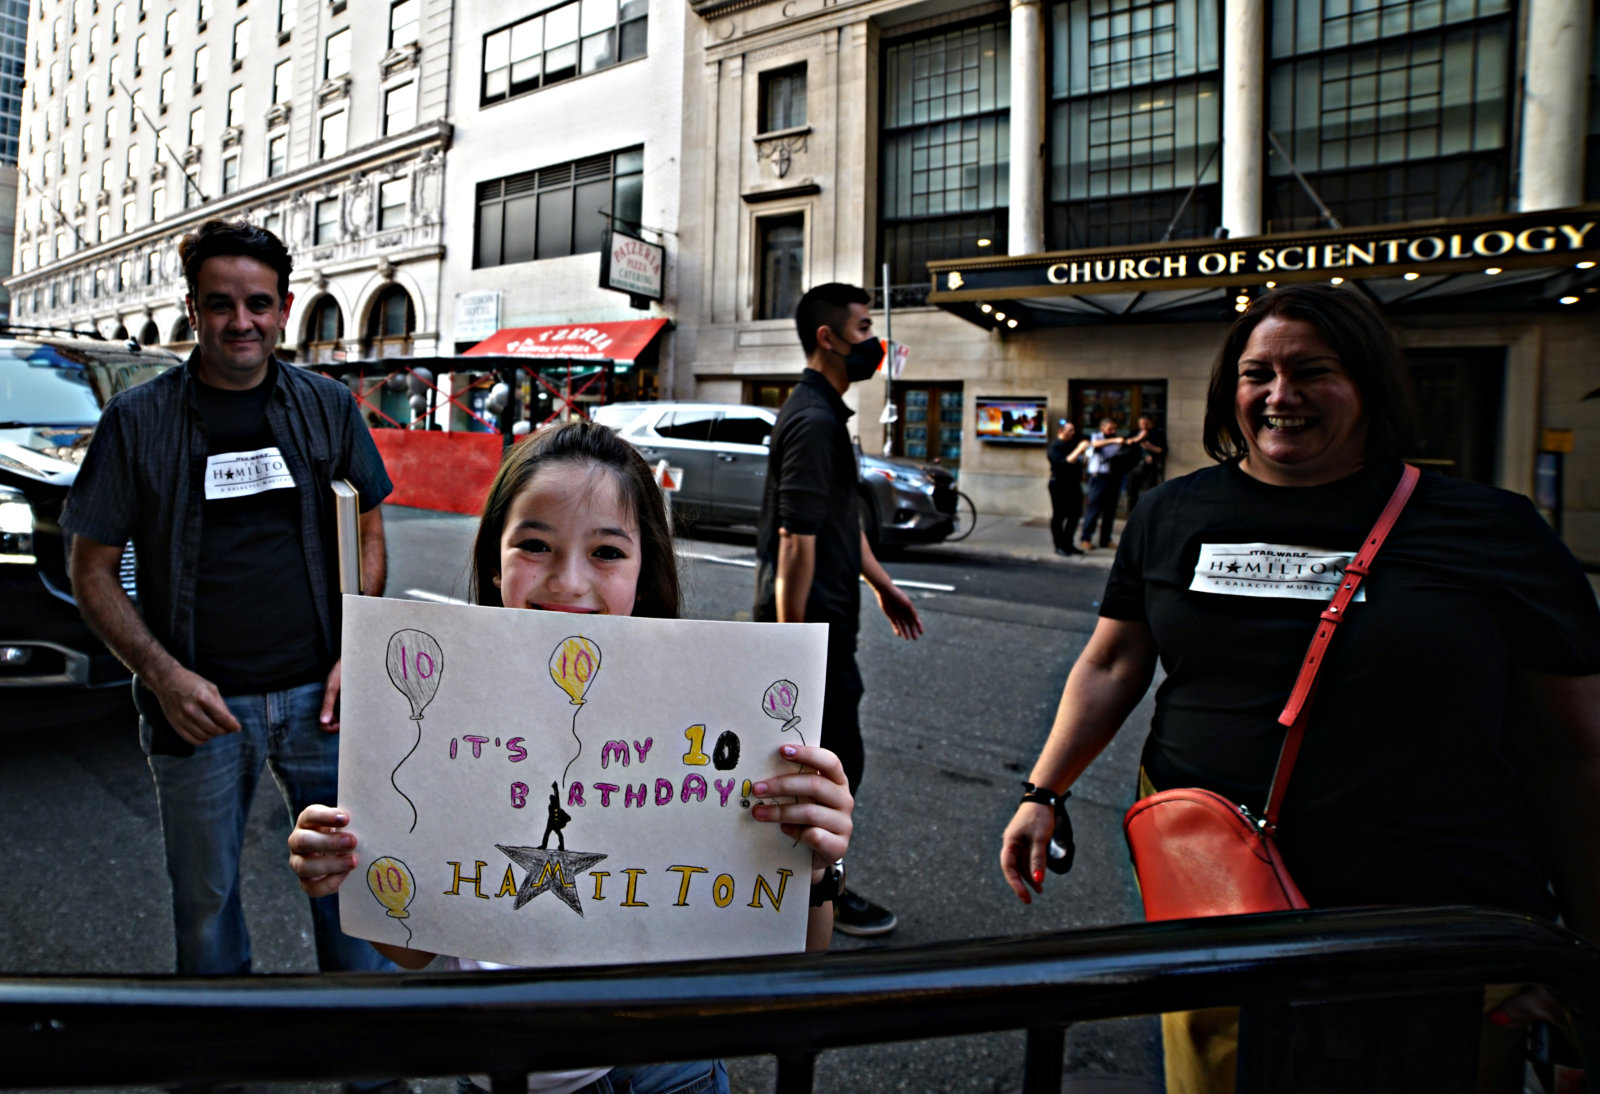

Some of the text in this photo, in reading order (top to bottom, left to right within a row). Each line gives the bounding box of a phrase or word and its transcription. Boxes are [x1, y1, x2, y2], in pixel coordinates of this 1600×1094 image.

[613, 241, 661, 275] PATZERIA
[627, 257, 647, 273] PIZZA
[1046, 222, 1597, 284] CHURCH OF SCIENTOLOGY
[618, 267, 653, 285] CATERING
[464, 306, 491, 317] HOTEL
[1265, 556, 1290, 564] THE
[1225, 581, 1280, 590] GALACTIC
[1252, 573, 1300, 581] SAGA
[401, 645, 434, 681] 10
[562, 649, 593, 683] 10
[769, 686, 792, 711] 10
[449, 723, 741, 771] IT'S MY 10
[375, 865, 402, 893] 10
[443, 859, 794, 912] HAMILTON
